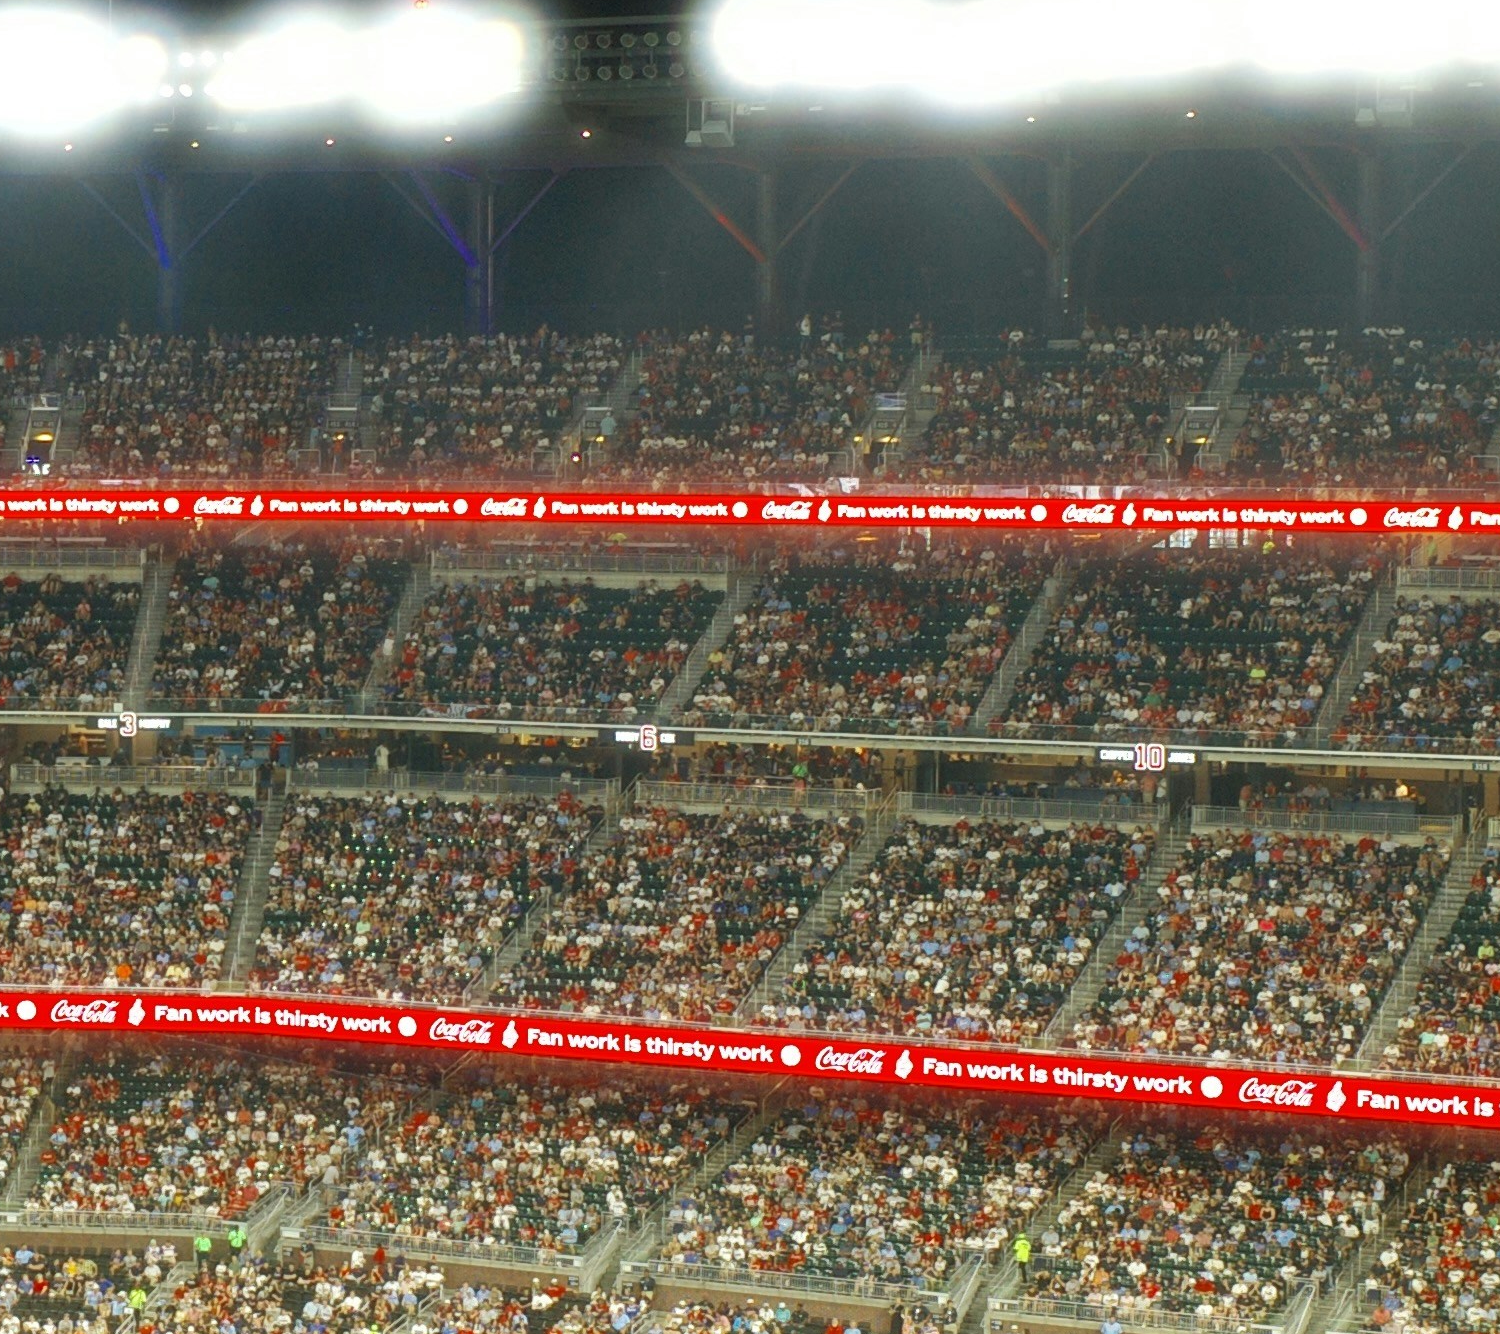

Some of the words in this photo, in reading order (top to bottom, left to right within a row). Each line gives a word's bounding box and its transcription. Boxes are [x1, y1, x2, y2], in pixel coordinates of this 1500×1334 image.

[120, 712, 136, 737] 3
[640, 725, 657, 751] 6
[1134, 743, 1165, 771] 10
[1238, 1077, 1317, 1107] Coca-Cola
[1358, 1090, 1399, 1109] Fan
[1405, 1096, 1468, 1114] work
[1474, 1097, 1494, 1116] is
